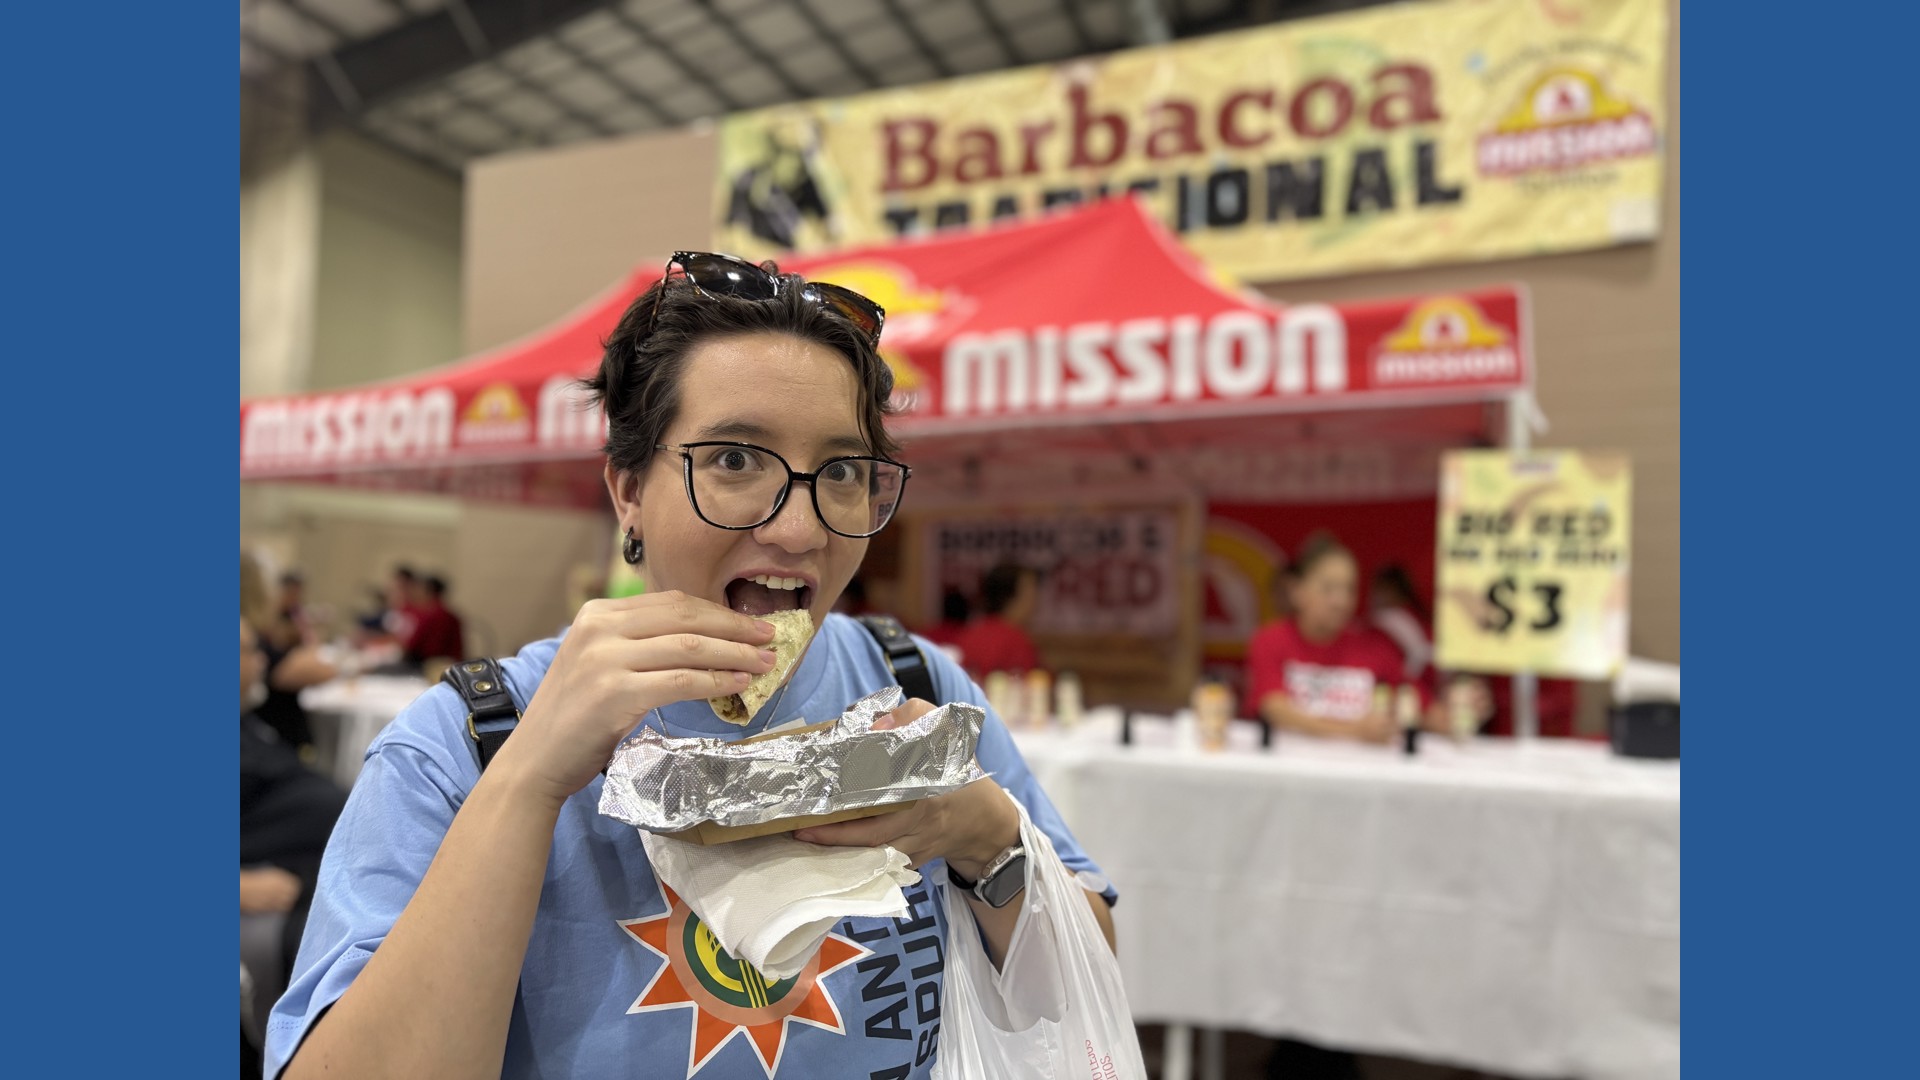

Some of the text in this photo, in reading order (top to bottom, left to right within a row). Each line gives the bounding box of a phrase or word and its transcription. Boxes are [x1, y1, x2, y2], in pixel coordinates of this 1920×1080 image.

[879, 60, 1442, 194] Barbacoa
[943, 304, 1347, 415] MISSION
[246, 388, 455, 465] MISSION
[1484, 573, 1564, 640] $3
[843, 916, 913, 1041] ANT
[892, 868, 944, 1067] SPUR
